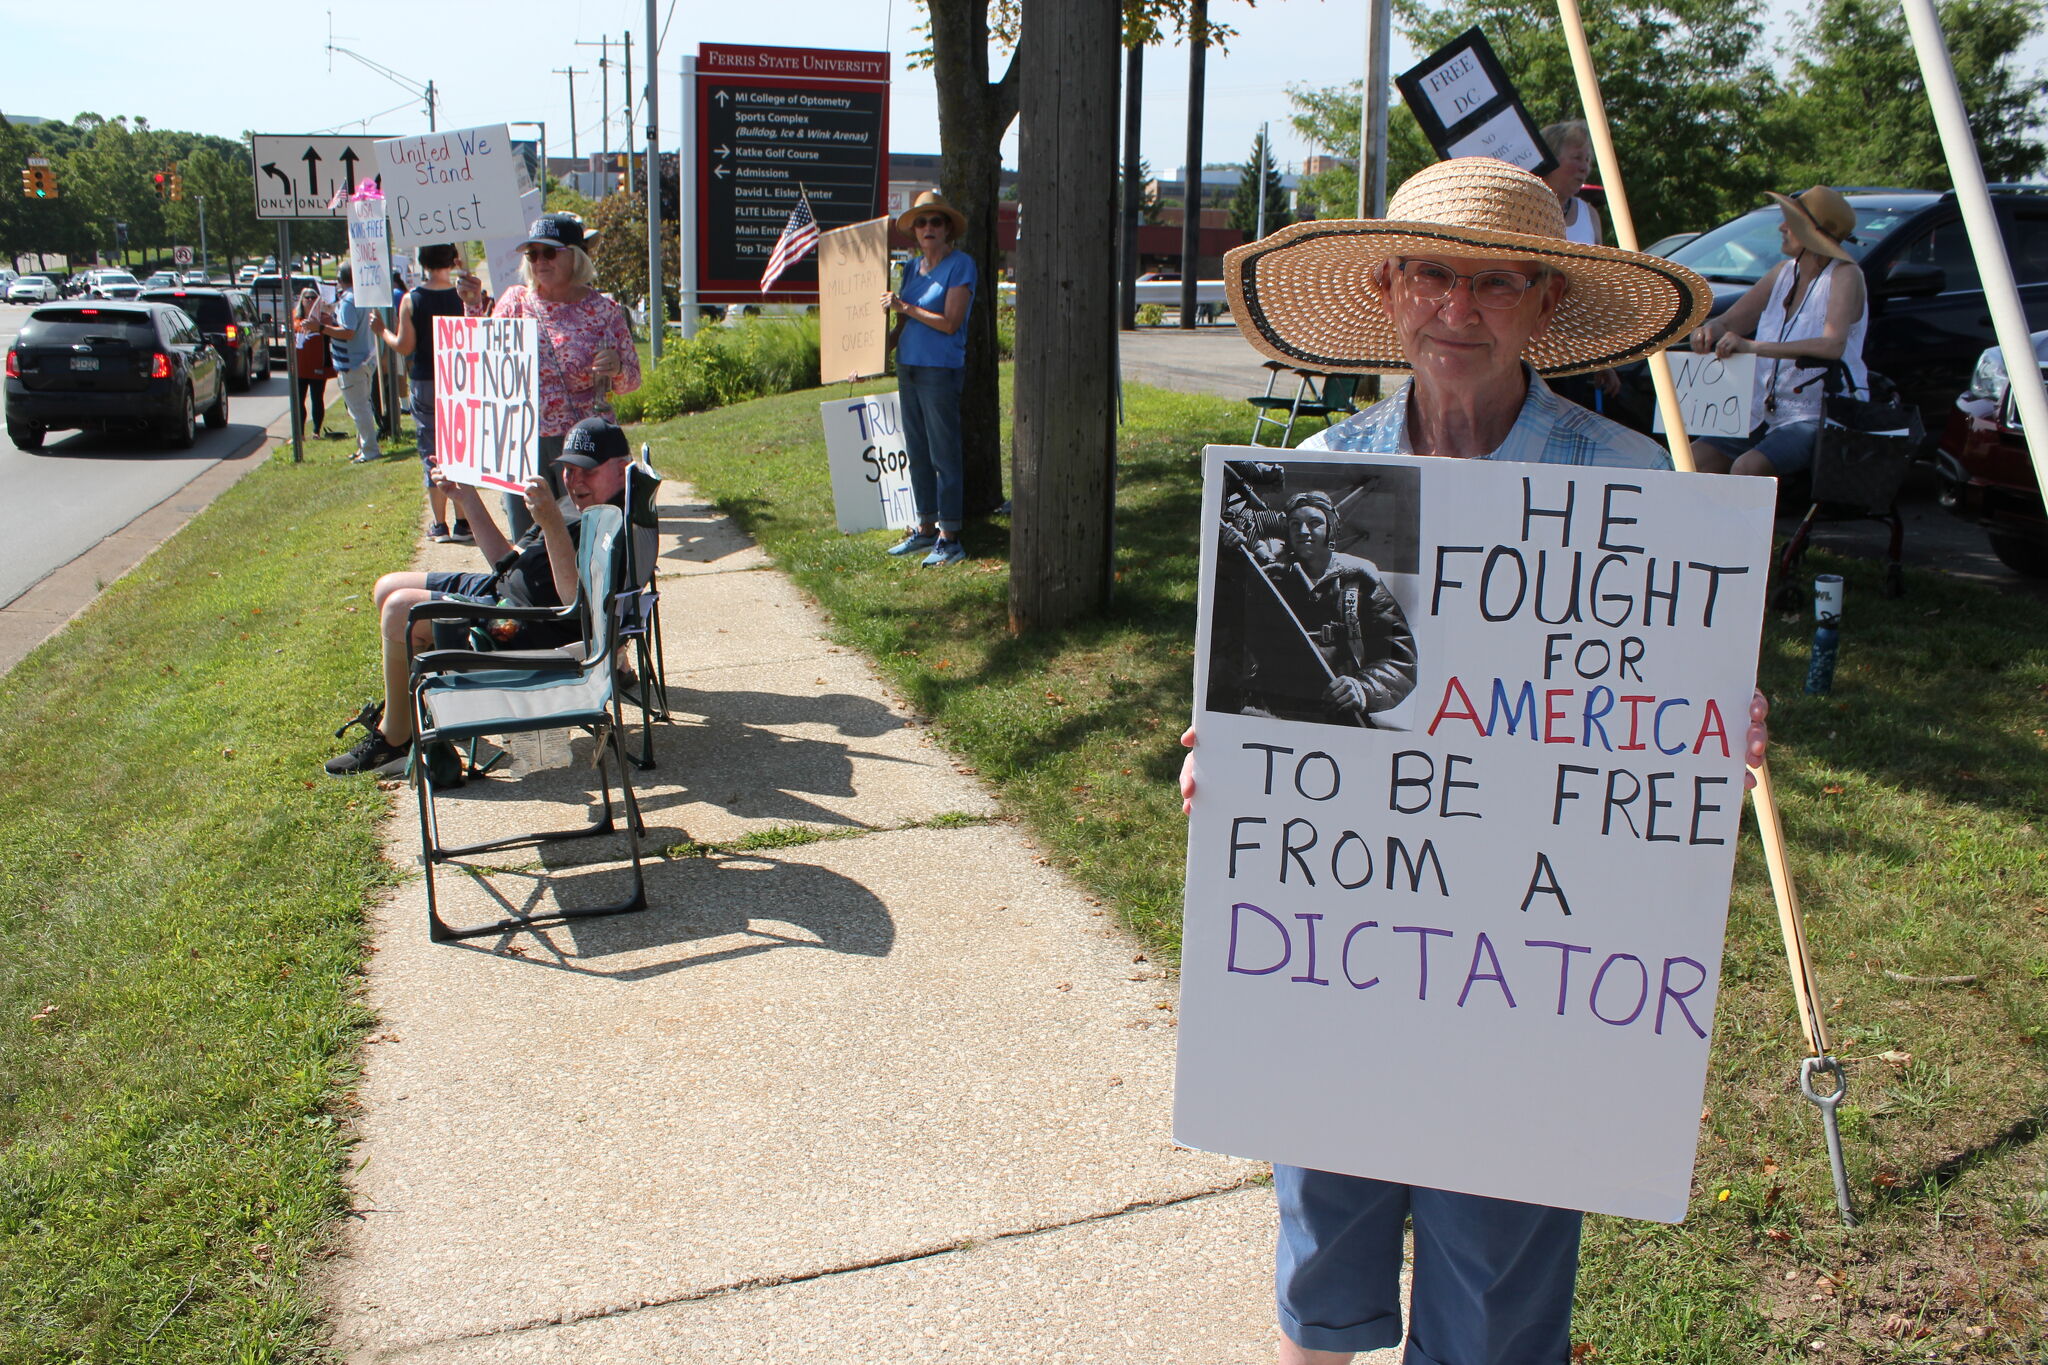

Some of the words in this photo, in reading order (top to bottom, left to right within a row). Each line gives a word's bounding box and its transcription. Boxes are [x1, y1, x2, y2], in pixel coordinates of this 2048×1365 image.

[709, 51, 755, 66] FERRIS
[759, 53, 800, 69] STATE
[803, 55, 882, 73] UNIVERSITY
[1430, 55, 1474, 92] FREE
[735, 92, 748, 102] MI
[750, 93, 785, 105] College
[787, 94, 798, 104] of
[800, 95, 851, 108] Optometry
[1454, 88, 1481, 113] DC
[735, 112, 766, 123] Sports
[768, 113, 809, 125] Complex
[390, 136, 451, 164] United
[458, 130, 492, 156] We
[780, 128, 795, 138] Ice
[796, 129, 804, 138] &
[807, 130, 831, 140] Wink
[833, 131, 868, 142] Arenas)
[1481, 134, 1496, 145] NO
[735, 148, 763, 158] Katke
[765, 148, 785, 158] Golf
[787, 150, 819, 160] Course
[416, 157, 474, 185] Stand
[736, 168, 789, 178] Admissions
[261, 198, 293, 209] ONLY
[298, 198, 330, 209] ONLY
[735, 187, 762, 197] David
[764, 188, 773, 198] L.
[774, 188, 800, 198] Eisler
[356, 202, 374, 218] USA
[397, 193, 486, 237] Resist
[735, 207, 760, 216] FLITE
[735, 226, 759, 235] Main
[761, 226, 783, 236] Entr
[356, 242, 377, 262] SINCE
[736, 244, 754, 254] Top
[360, 265, 382, 287] 1776
[828, 270, 879, 297] MILITARY
[845, 301, 871, 321] TAKE
[438, 318, 478, 352] NOT
[482, 318, 525, 353] THEN
[438, 351, 479, 396] NOT
[1676, 357, 1724, 389] NO
[848, 401, 901, 441] TRU
[437, 398, 481, 468] NOT
[481, 400, 535, 483] EVER
[574, 441, 596, 452] EVER
[862, 445, 908, 483] Stop
[1520, 476, 1646, 554] HE
[1430, 545, 1750, 629] FOUGHT
[1543, 632, 1647, 683] FOR
[1428, 676, 1731, 759] AMERICA
[1242, 742, 1341, 802] TO
[1389, 749, 1482, 820] BE
[1552, 763, 1729, 846] FREE
[1228, 816, 1450, 897] FROM
[1520, 852, 1572, 916] A
[1226, 902, 1708, 1040] DICTATOR
